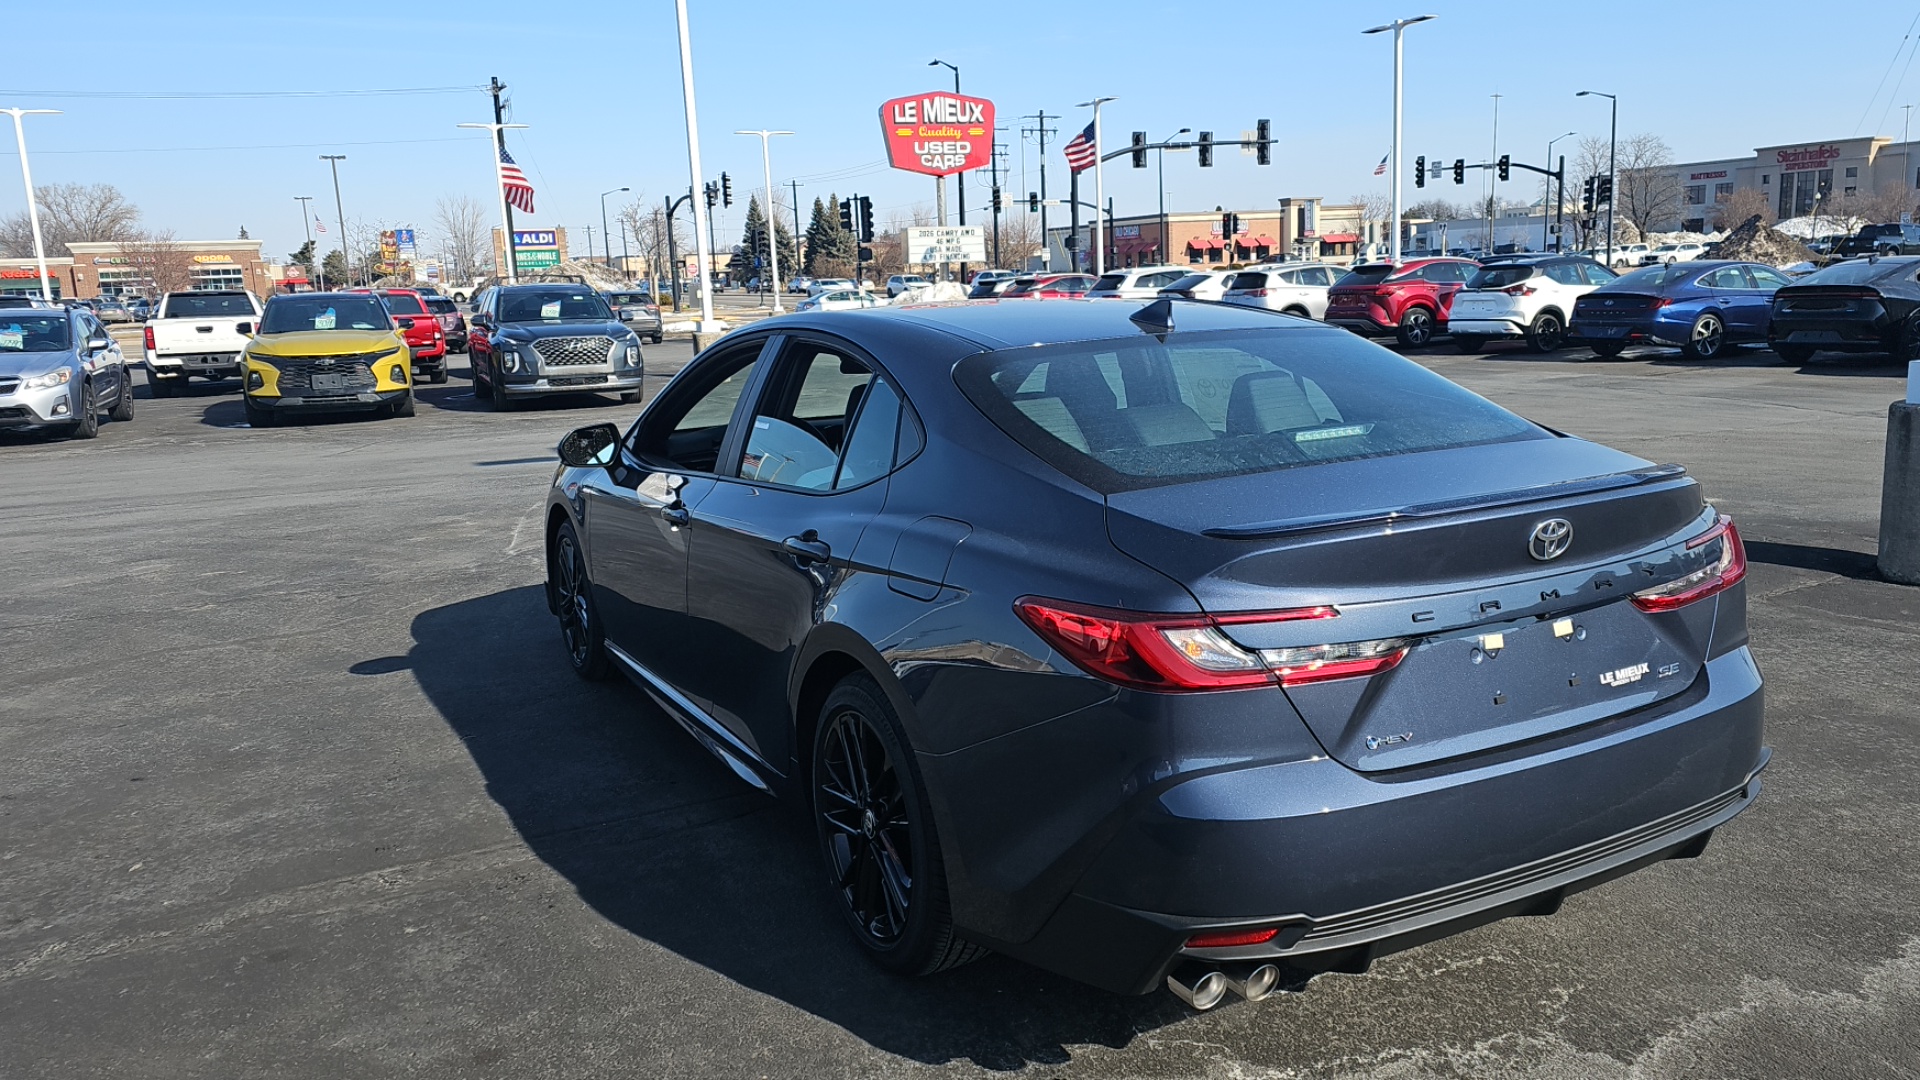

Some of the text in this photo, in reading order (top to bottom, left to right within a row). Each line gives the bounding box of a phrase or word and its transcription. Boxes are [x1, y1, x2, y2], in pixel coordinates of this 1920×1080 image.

[893, 96, 985, 124] LE MIEUX
[918, 126, 963, 139] Quality
[914, 141, 971, 155] USED
[1777, 145, 1840, 163] Steinhafels
[921, 154, 966, 170] CARS
[1785, 160, 1828, 171] SUPERSTORE
[1690, 171, 1728, 180] MATTRESSES
[522, 233, 553, 244] ALDI
[937, 229, 959, 237] CAMRY
[194, 255, 233, 263] QDOBA
[537, 251, 557, 260] NOBLE
[1411, 565, 1658, 624] CAMRY
[1600, 662, 1650, 685] LE MIEUX
[1658, 662, 1680, 678] SE
